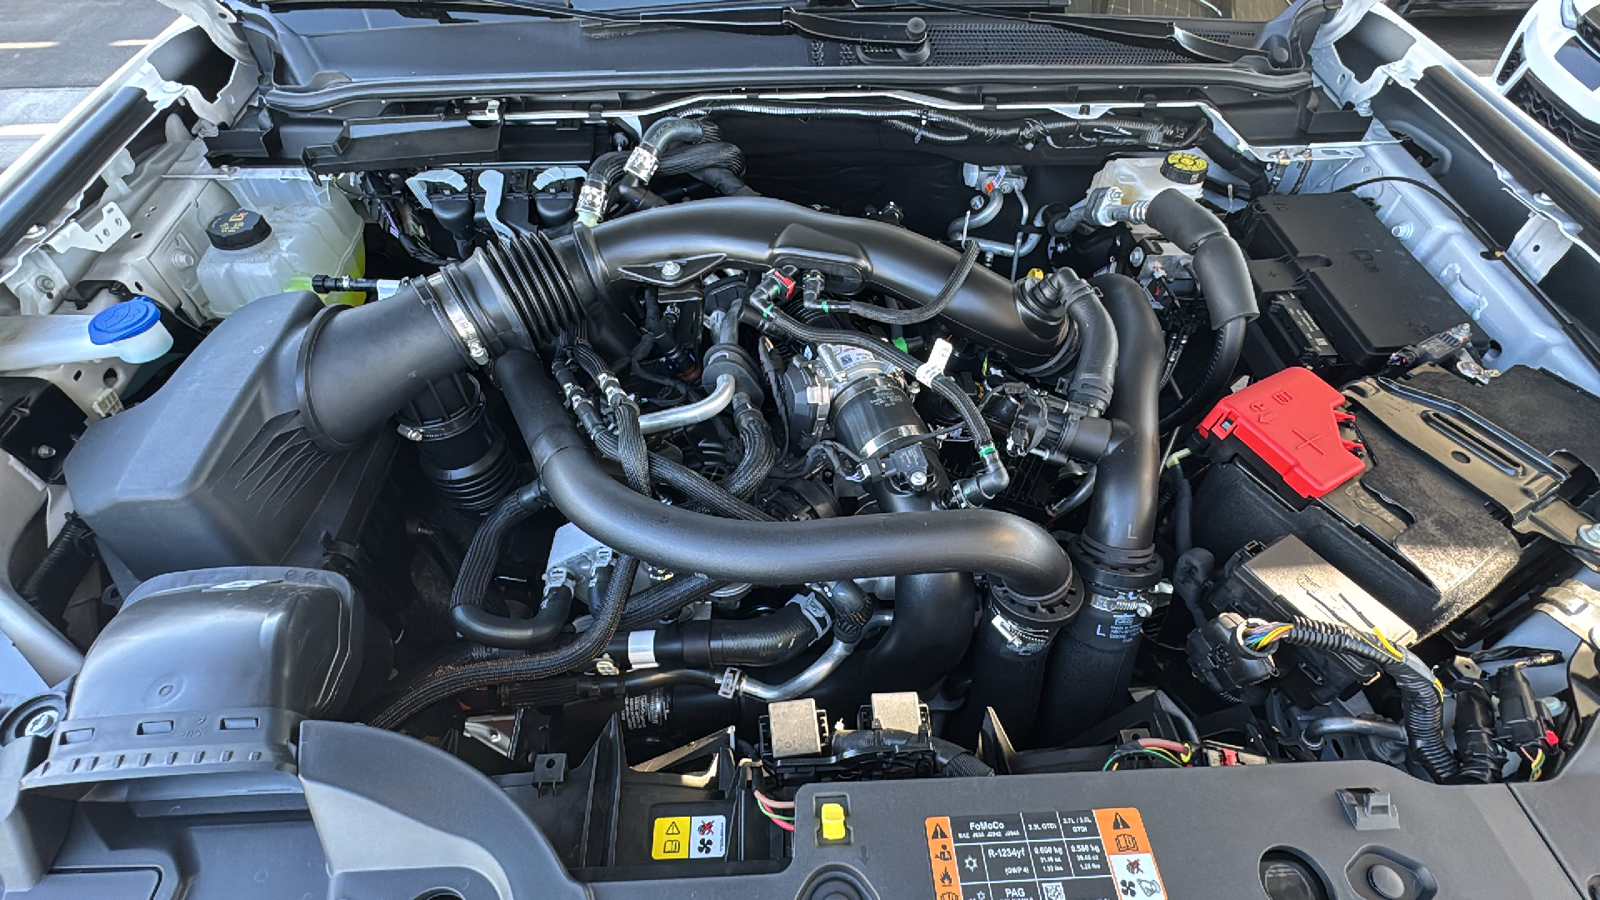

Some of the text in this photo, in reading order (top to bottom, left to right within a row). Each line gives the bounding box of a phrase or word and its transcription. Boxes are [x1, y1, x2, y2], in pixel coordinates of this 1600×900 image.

[1127, 523, 1138, 539] L
[1096, 624, 1106, 637] L
[969, 821, 1005, 830] FoMoCo
[988, 846, 1025, 859] R-1234yf
[1053, 846, 1063, 855] kg
[1090, 843, 1100, 853] kg
[1004, 887, 1026, 898] PAG
